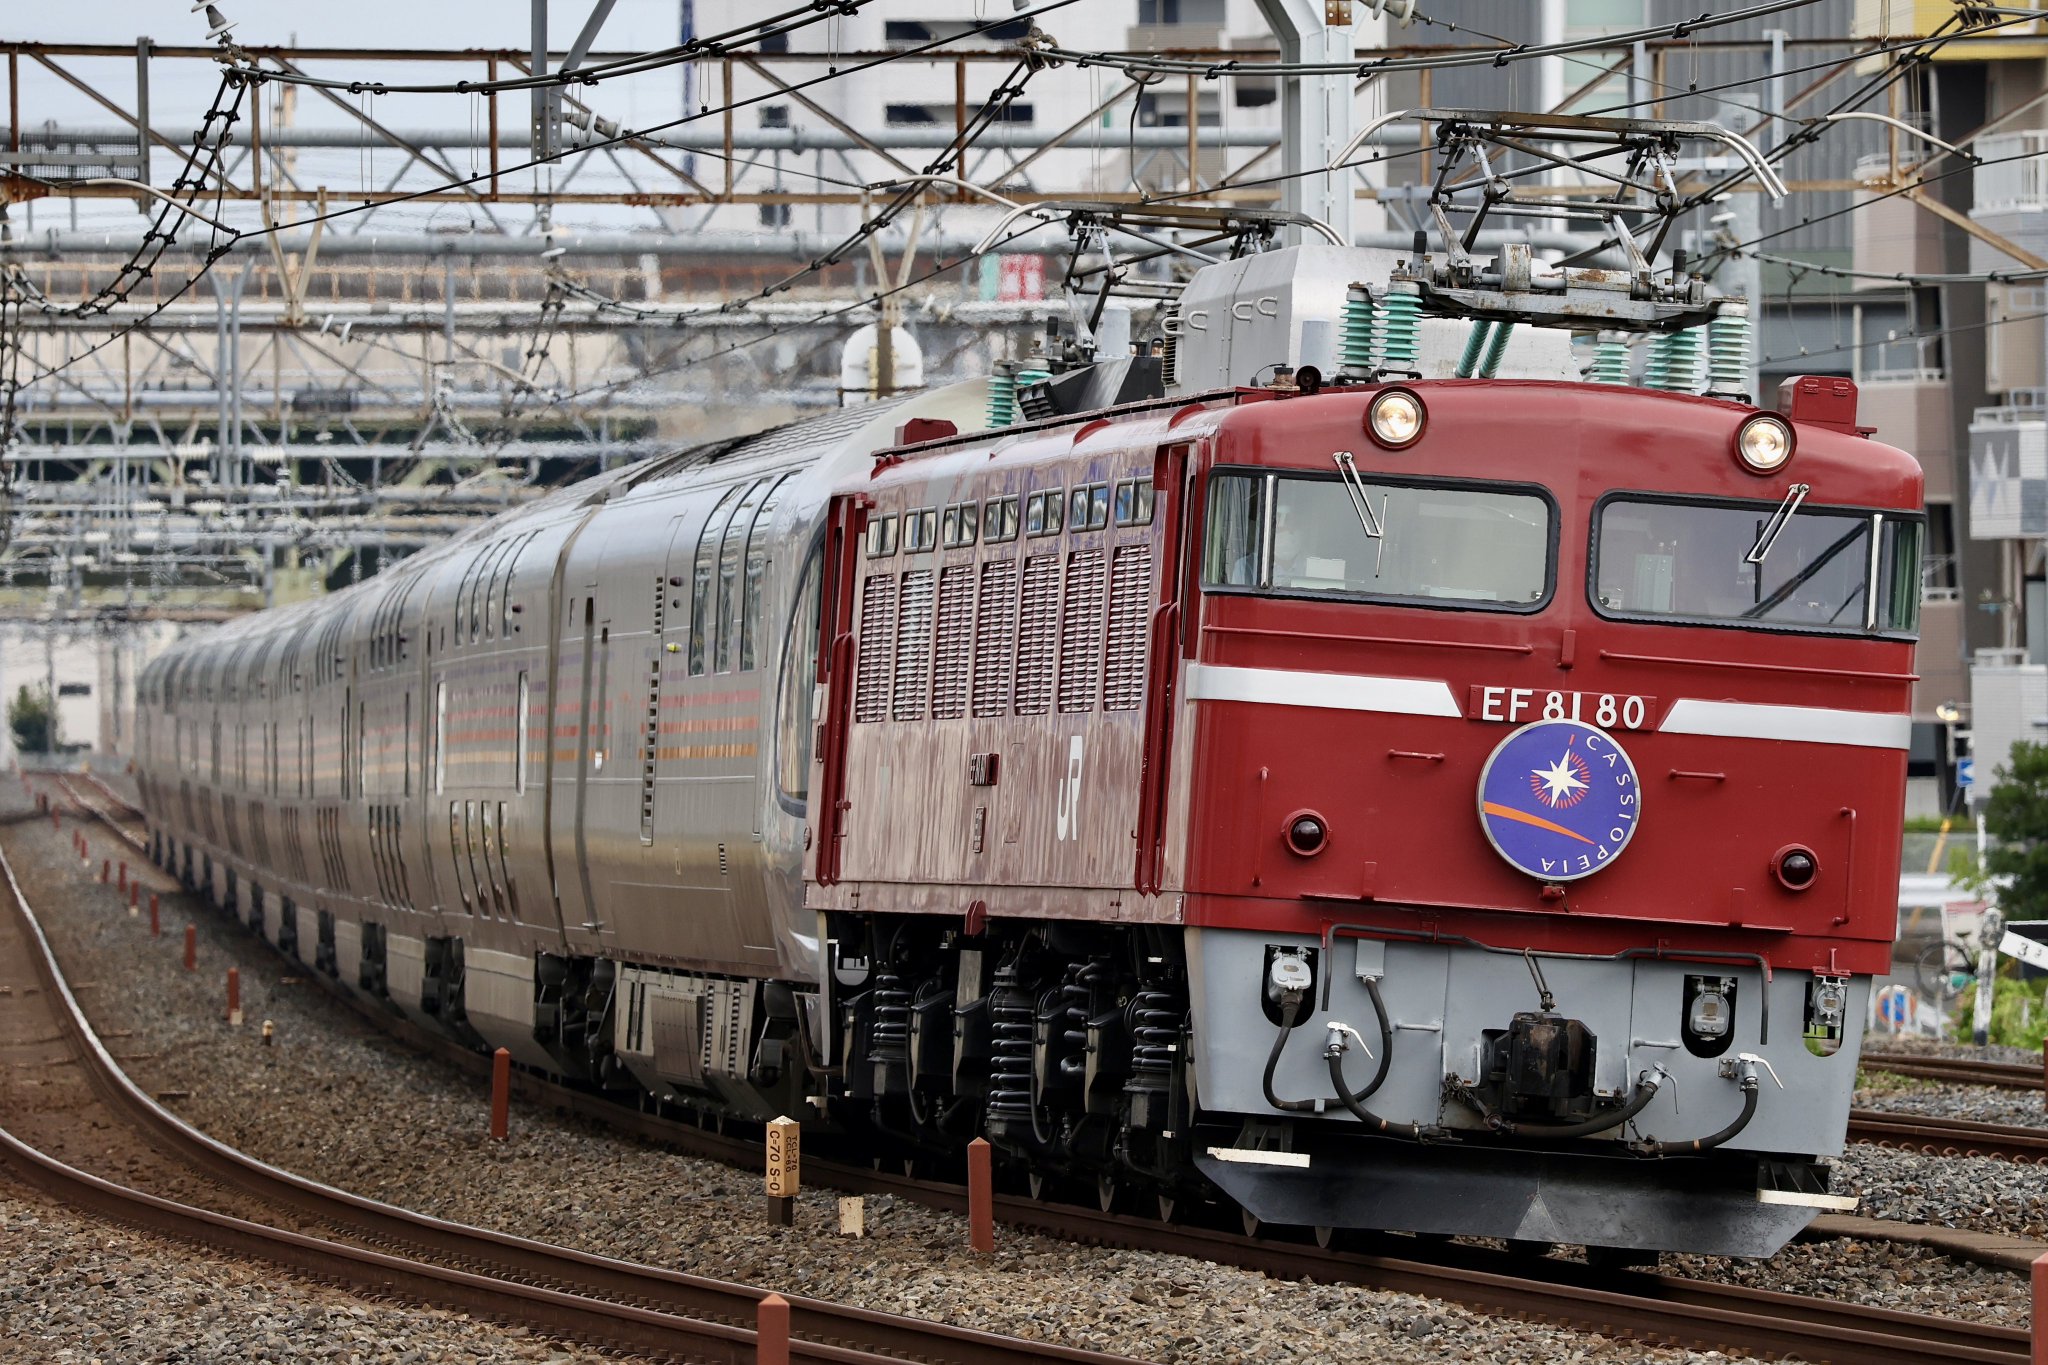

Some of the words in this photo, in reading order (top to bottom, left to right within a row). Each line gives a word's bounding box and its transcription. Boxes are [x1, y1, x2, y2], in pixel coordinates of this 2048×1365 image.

[1482, 686, 1533, 722] EF
[1543, 691, 1581, 721] 81
[1596, 694, 1645, 729] 80
[1057, 735, 1083, 841] JR
[1540, 735, 1634, 872] CASSIOPEIA
[769, 1130, 781, 1162] C=70
[769, 1167, 781, 1191] S=0
